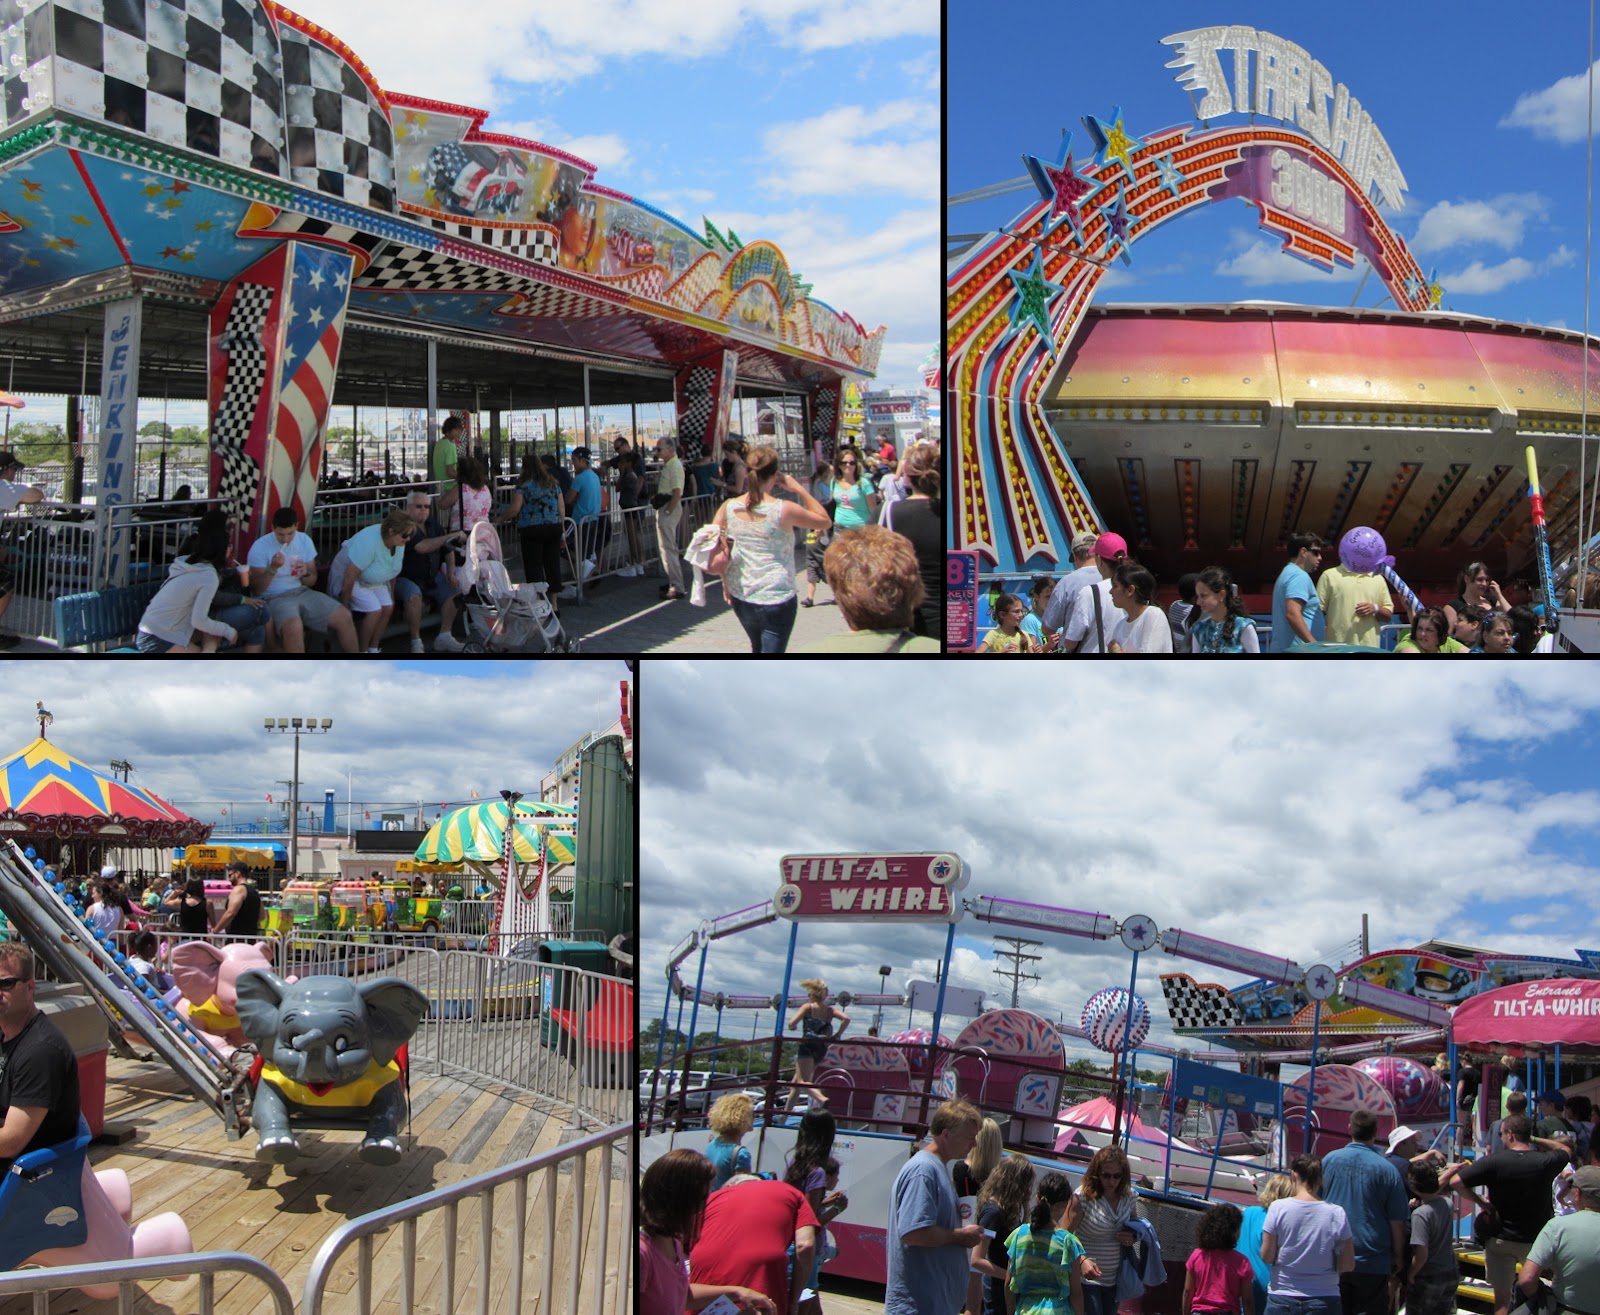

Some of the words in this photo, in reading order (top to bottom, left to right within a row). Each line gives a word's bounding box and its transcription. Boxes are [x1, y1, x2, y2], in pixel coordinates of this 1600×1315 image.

[1159, 25, 1409, 212] STARSHIP
[1270, 148, 1346, 235] 3000
[947, 589, 974, 599] KETS
[830, 886, 944, 911] WHIRL
[1525, 983, 1582, 998] Entrance
